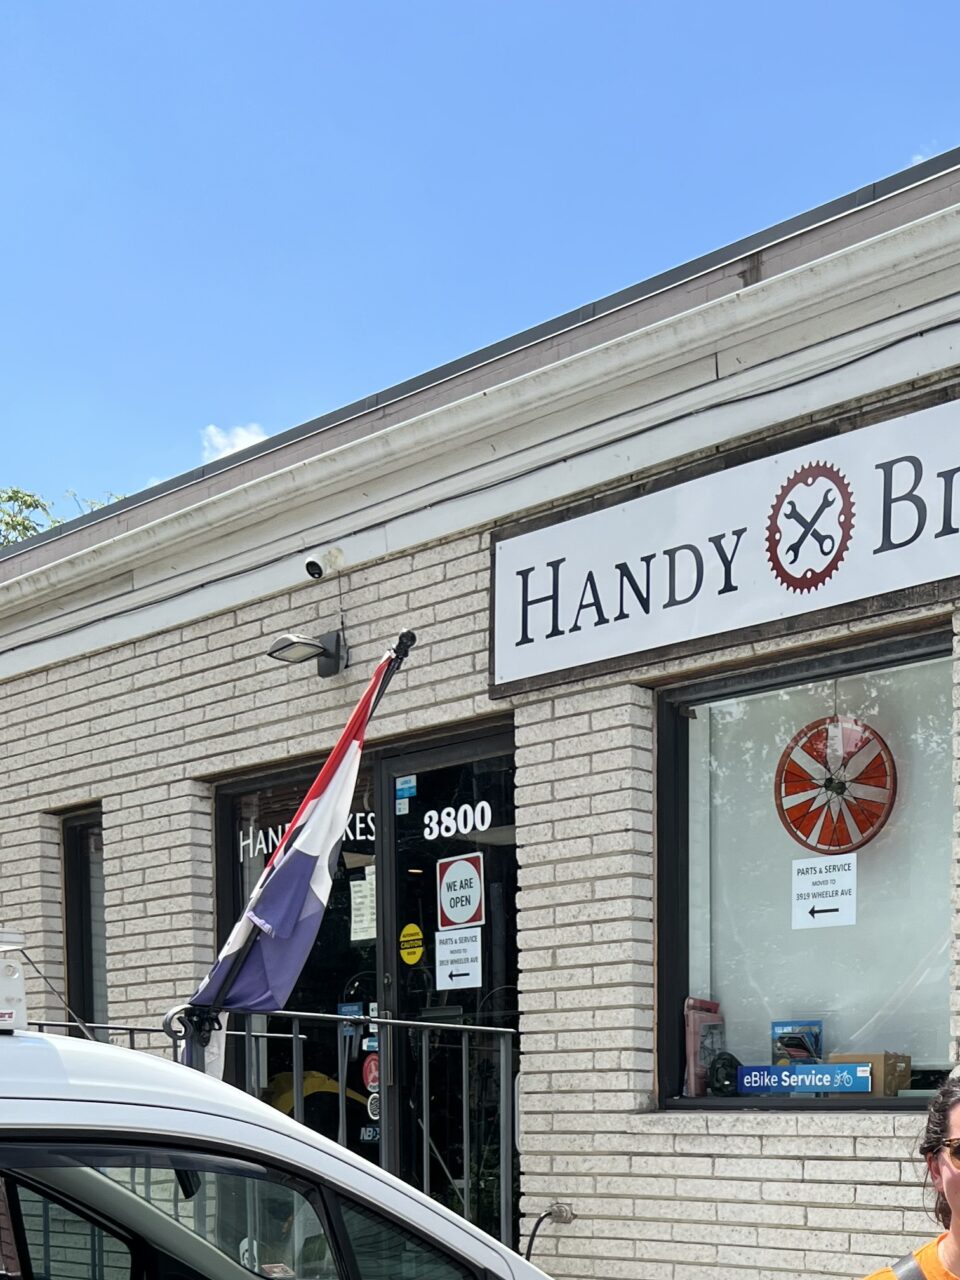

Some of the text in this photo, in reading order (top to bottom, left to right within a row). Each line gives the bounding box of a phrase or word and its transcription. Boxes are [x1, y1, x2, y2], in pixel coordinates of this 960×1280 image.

[515, 527, 747, 646] HANDY
[423, 800, 492, 840] 3800
[239, 812, 376, 863] HAN KES
[796, 866, 817, 876] PARTS
[824, 863, 852, 873] SERVICE
[446, 878, 474, 892] WE ARE
[449, 894, 471, 909] OPEN
[811, 890, 839, 900] WHEELER
[840, 888, 852, 897] AVE
[743, 1070, 831, 1087] eBike Service
